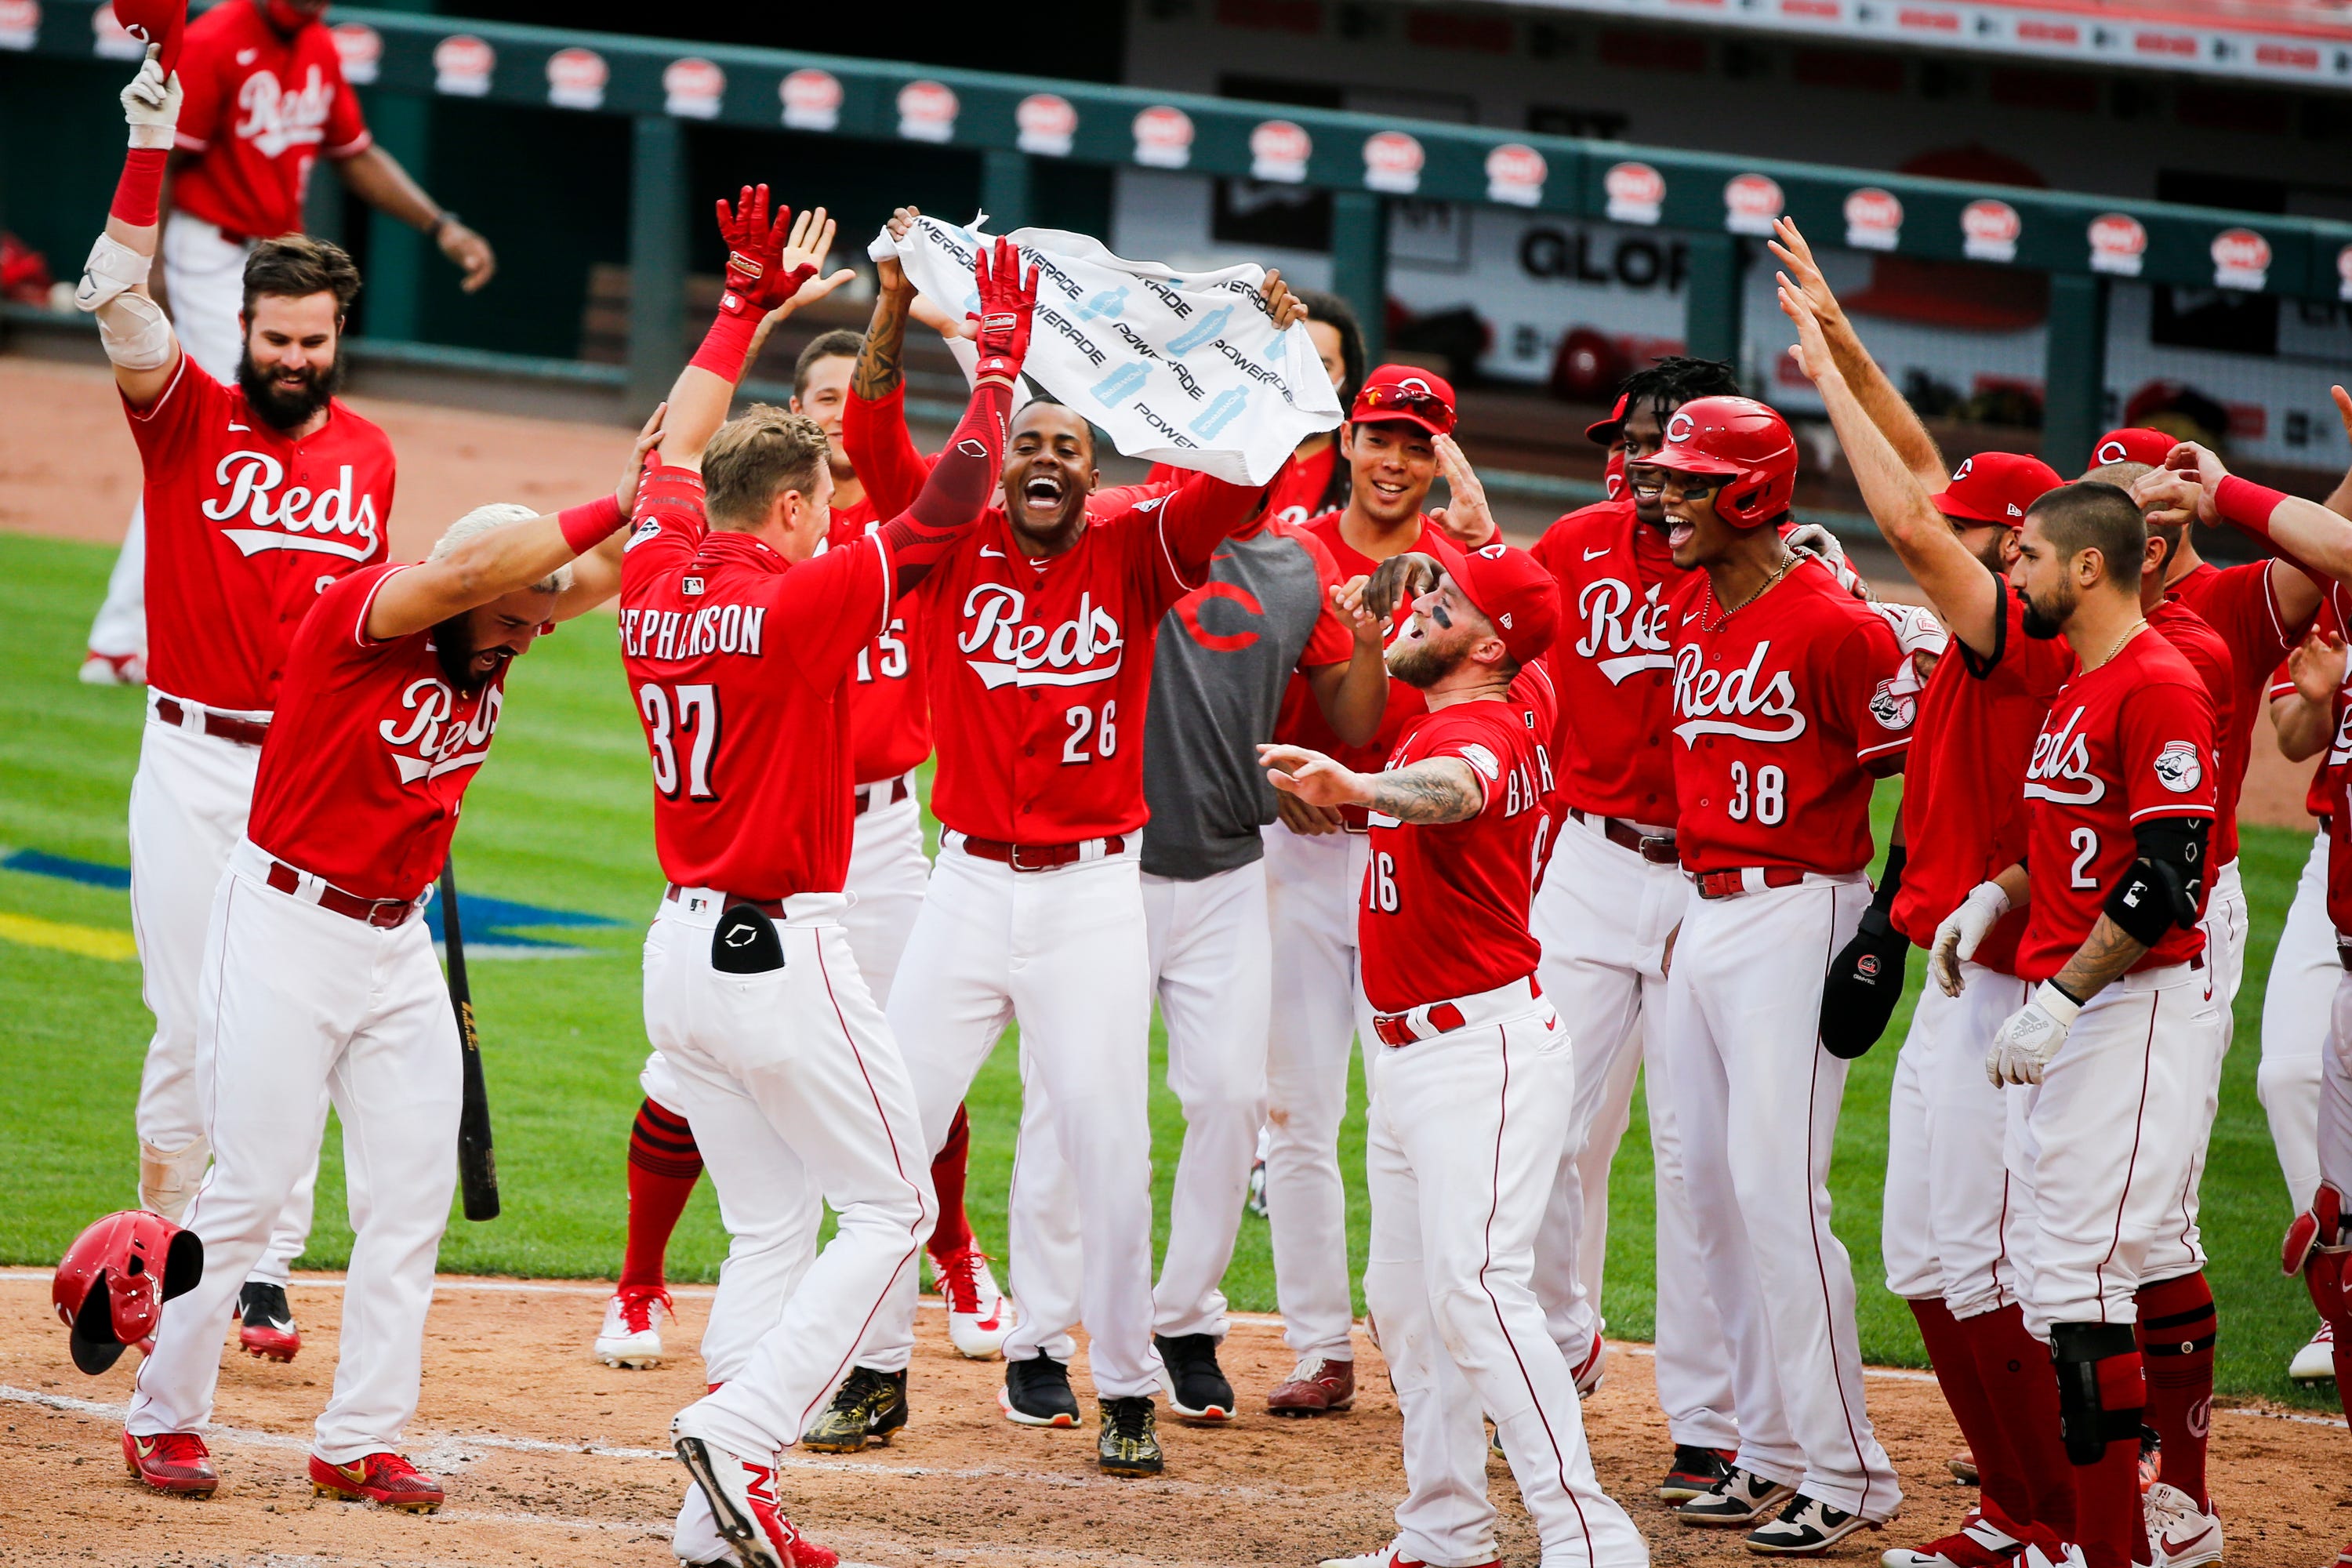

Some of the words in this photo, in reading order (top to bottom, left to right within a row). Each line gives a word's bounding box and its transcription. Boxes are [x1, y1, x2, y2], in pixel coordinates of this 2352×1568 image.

[1666, 412, 1695, 443] C
[2097, 441, 2127, 465] C
[1952, 458, 1973, 481] C
[201, 450, 378, 562] Reds
[957, 583, 1123, 689] Reds
[1173, 581, 1265, 652] C
[1672, 640, 1806, 745] Reds
[639, 682, 720, 800] 37
[1061, 699, 1119, 765] 26
[2025, 706, 2105, 804] eds
[1728, 760, 1787, 826] 38
[1369, 848, 1400, 913] 16
[2070, 826, 2100, 890] 2
[2012, 1021, 2049, 1040] adidas
